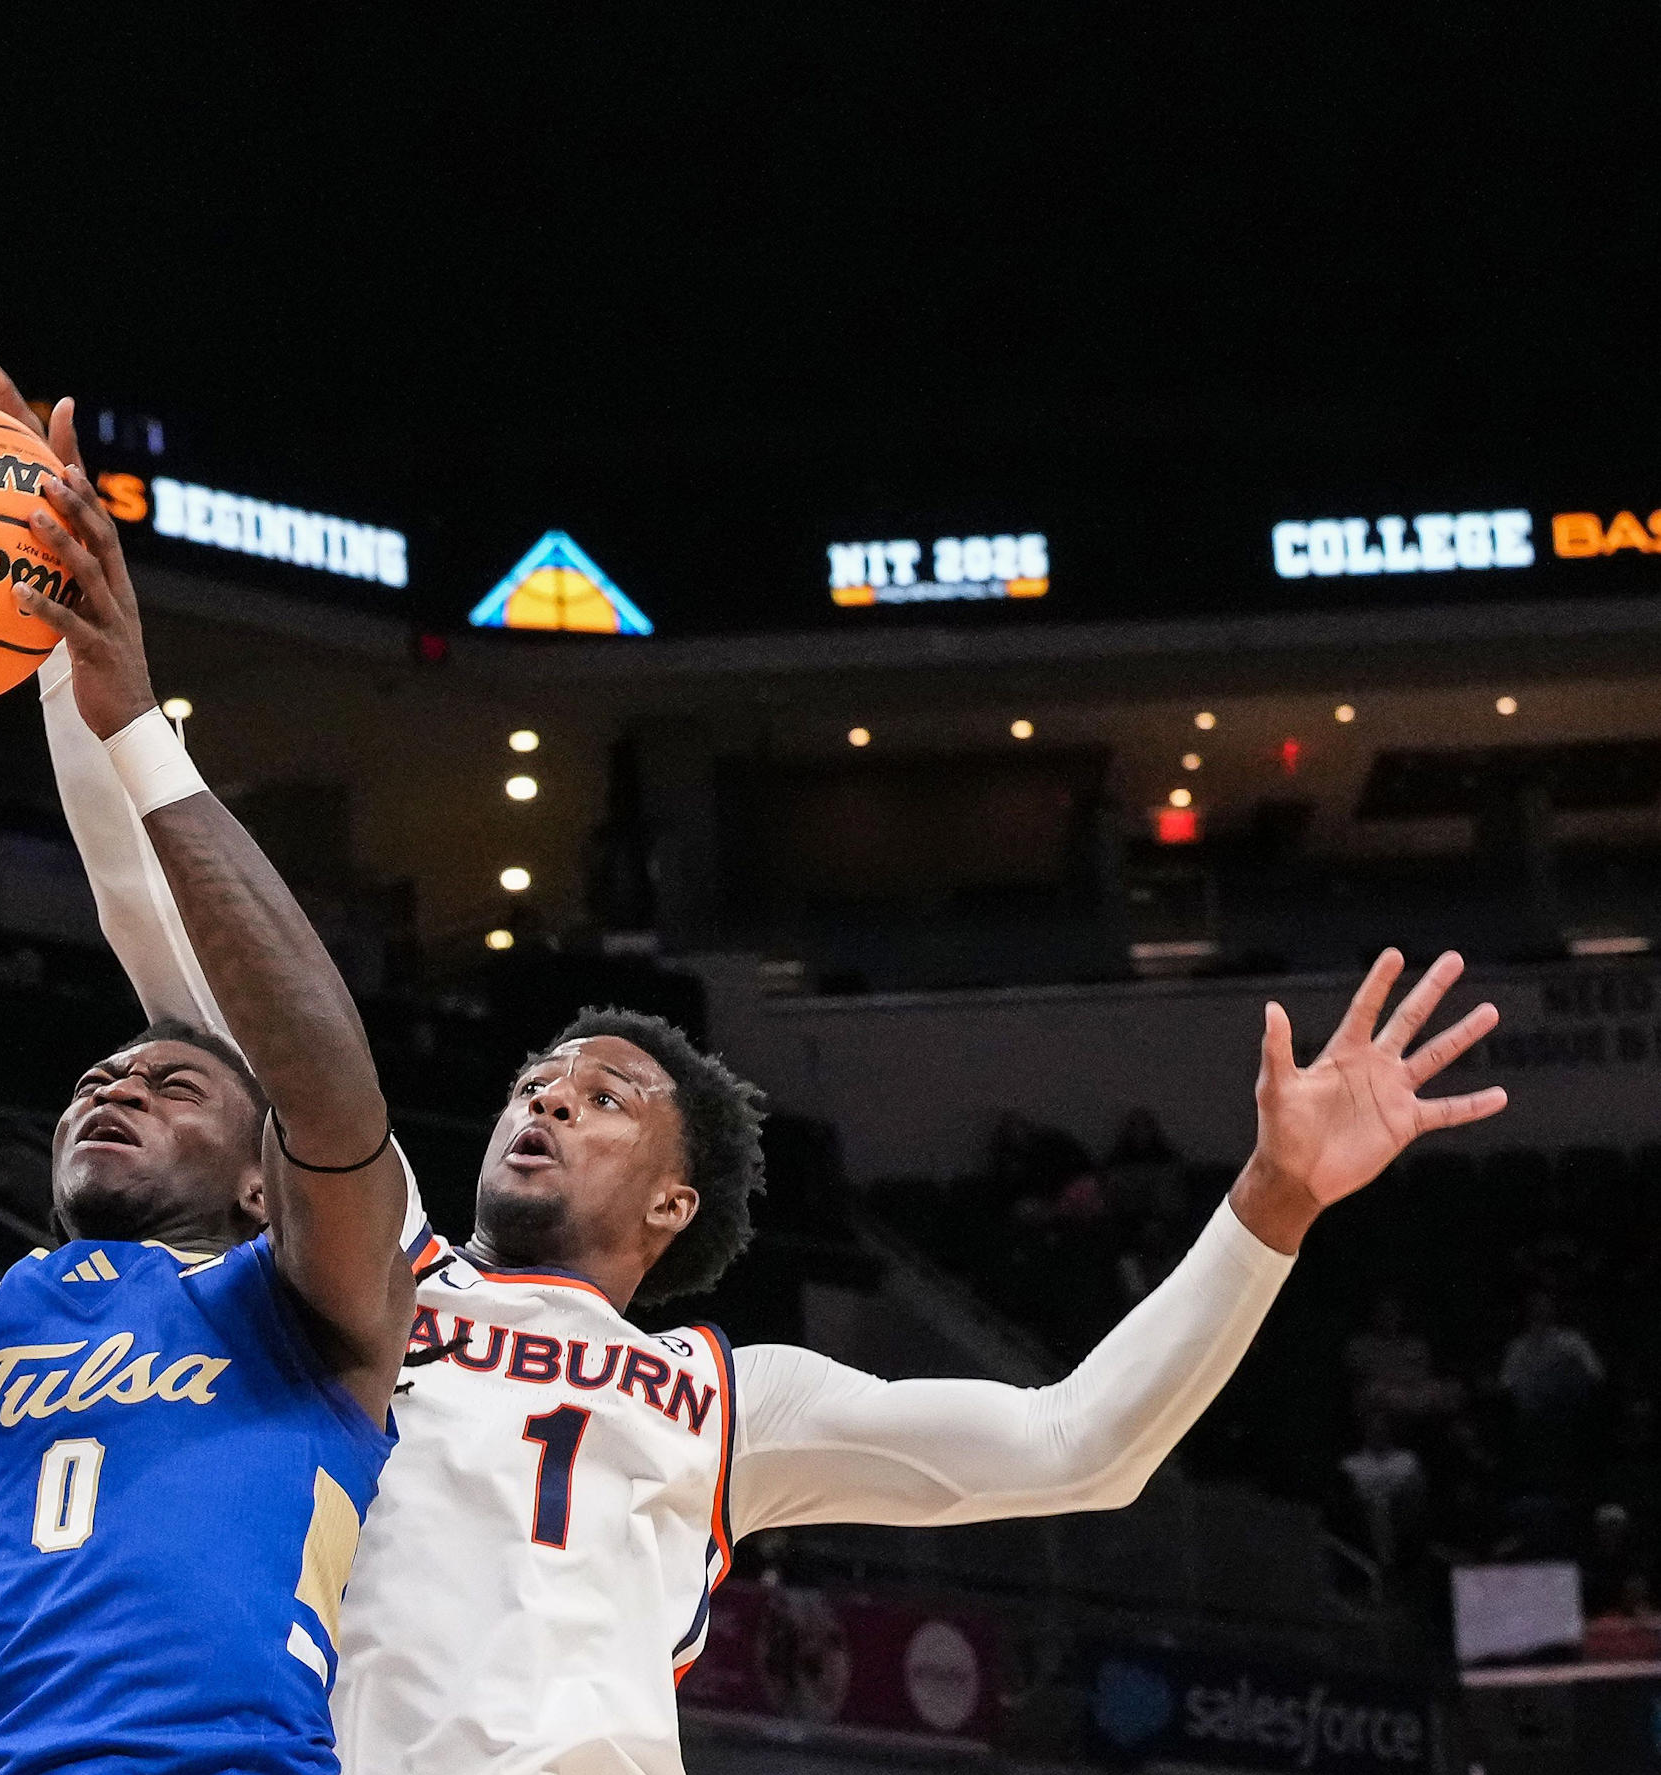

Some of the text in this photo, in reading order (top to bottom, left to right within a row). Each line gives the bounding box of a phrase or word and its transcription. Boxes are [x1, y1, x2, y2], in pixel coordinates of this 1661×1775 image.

[151, 475, 410, 590] BEGINNING
[828, 540, 921, 588] NIT
[1271, 508, 1536, 579] COLLEGE
[408, 1304, 716, 1436] AUBURN
[32, 1437, 105, 1553] 0
[522, 1403, 591, 1550] 1
[1184, 1676, 1424, 1768] salesforce
